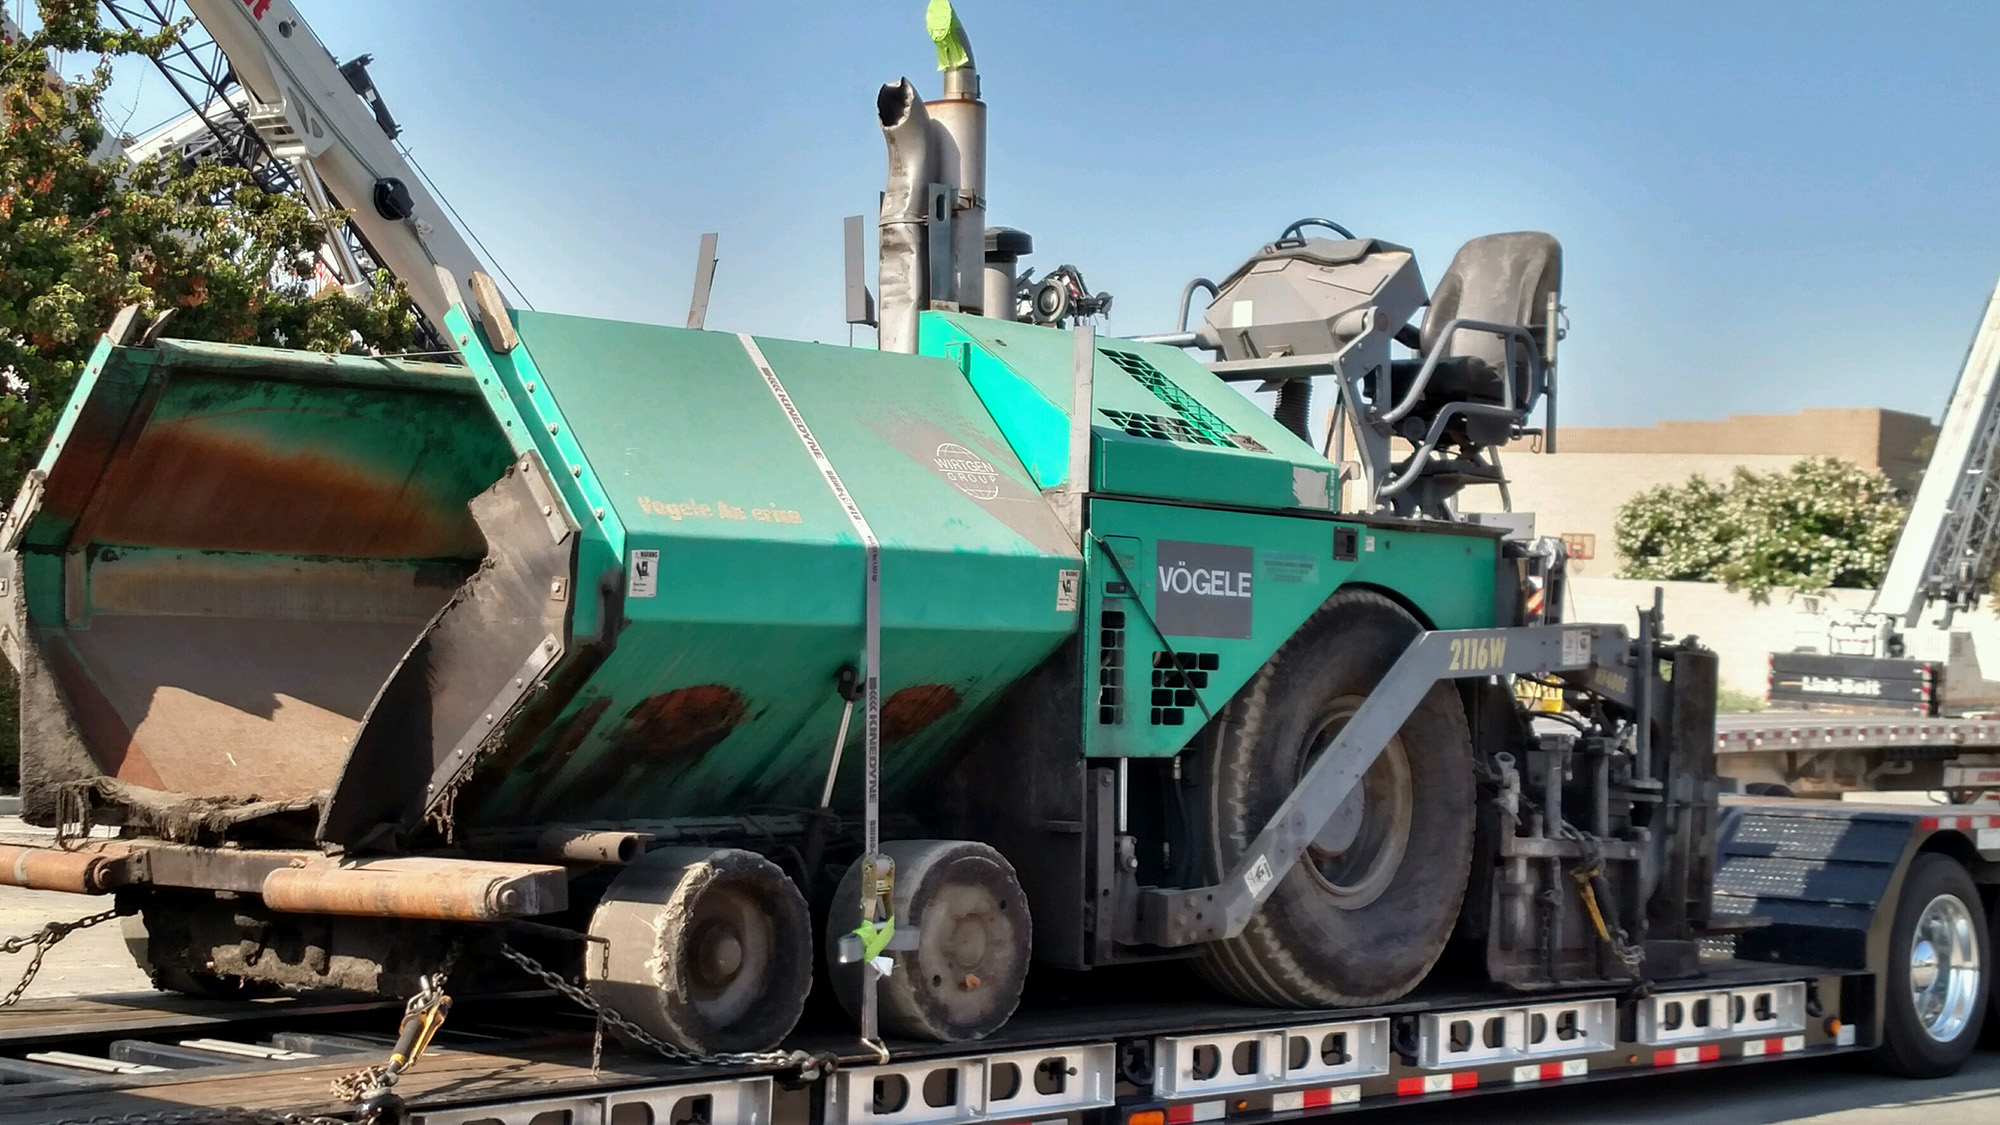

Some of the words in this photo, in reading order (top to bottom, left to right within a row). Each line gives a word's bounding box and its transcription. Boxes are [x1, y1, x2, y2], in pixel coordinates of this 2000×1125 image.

[778, 393, 825, 460] KINEDYNE
[934, 458, 994, 472] WIRTGEN
[947, 473, 997, 484] GROUP
[1158, 561, 1252, 597] VÖGELE
[1449, 637, 1507, 671] 2116W
[868, 714, 877, 803] KINEDYNE
